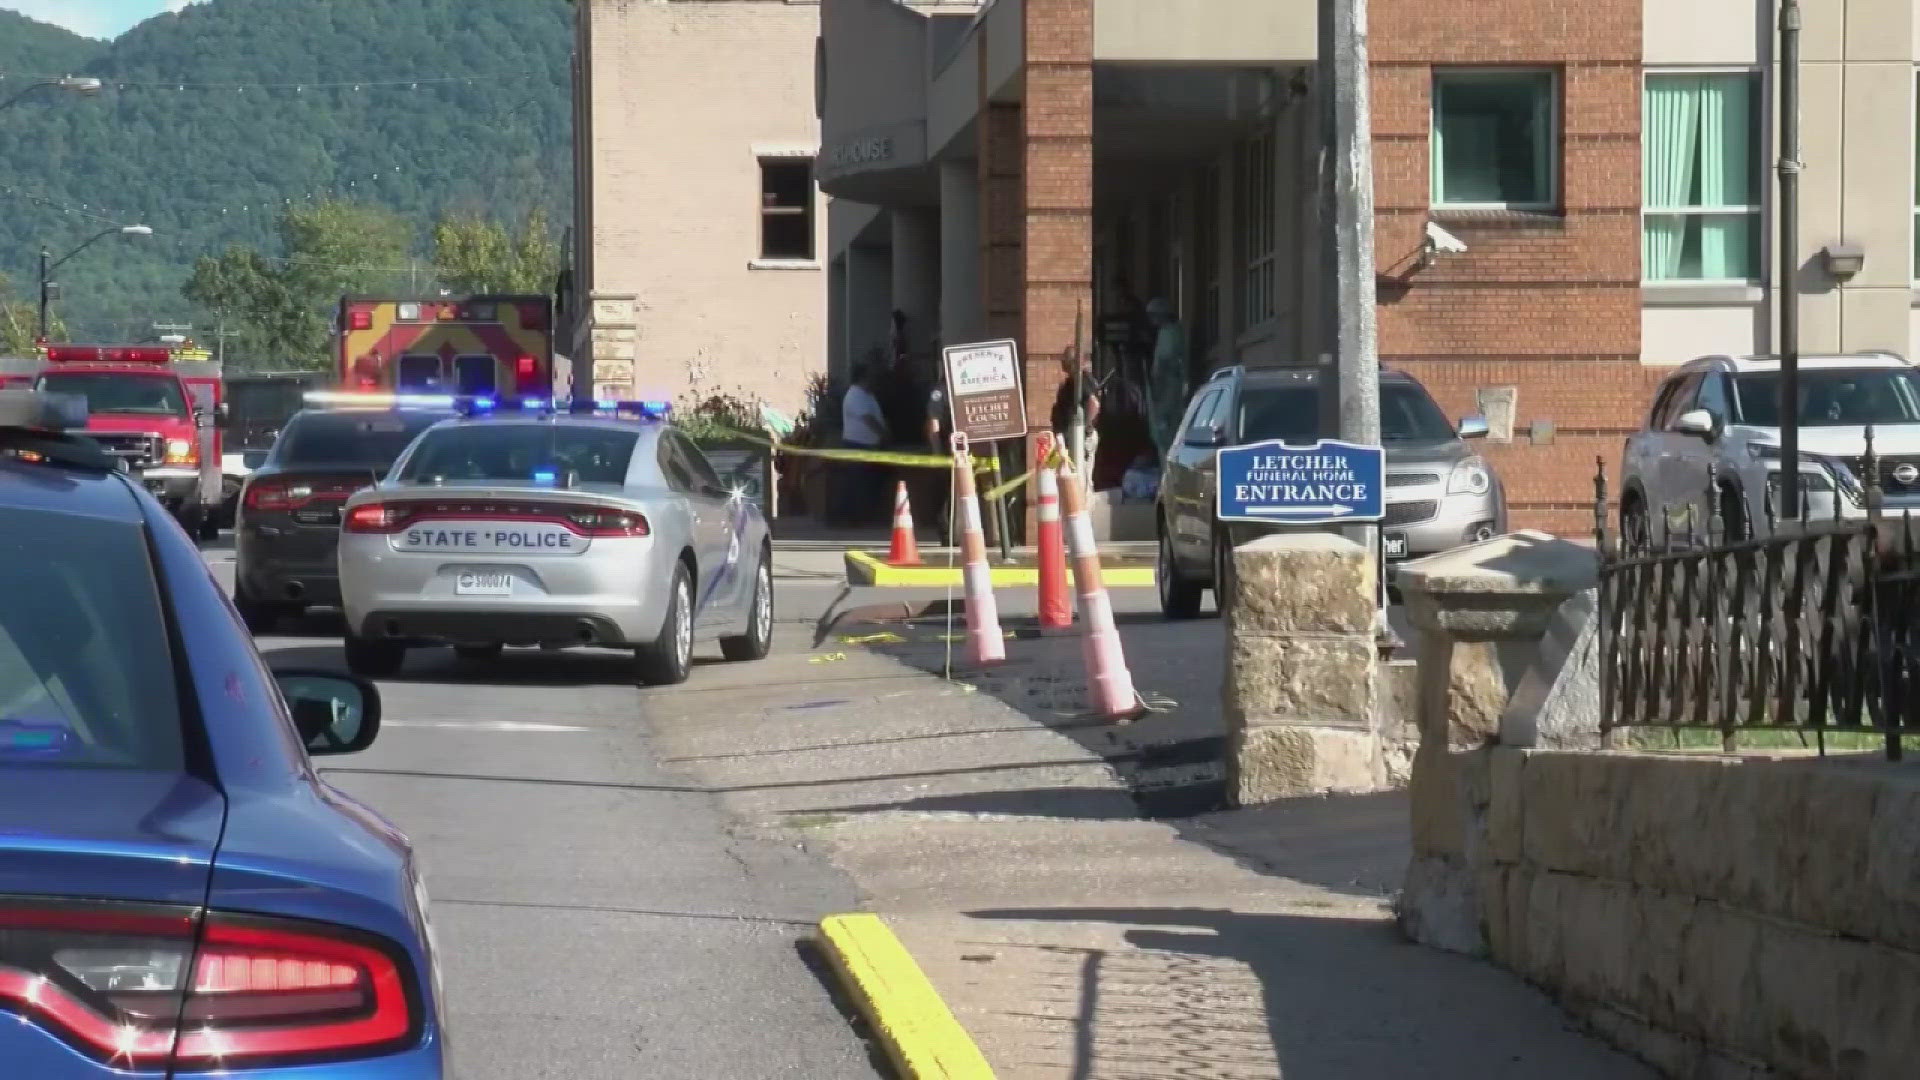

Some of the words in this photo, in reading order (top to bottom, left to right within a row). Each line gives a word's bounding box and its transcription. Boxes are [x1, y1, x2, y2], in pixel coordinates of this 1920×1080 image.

[967, 412, 1009, 423] COUNTY
[1252, 455, 1348, 470] LETCHER
[1247, 470, 1308, 482] FUNERAL
[1313, 469, 1355, 481] HOME
[1235, 484, 1368, 501] ENTRANCE
[407, 529, 478, 547] STATE
[495, 531, 572, 548] POLICE
